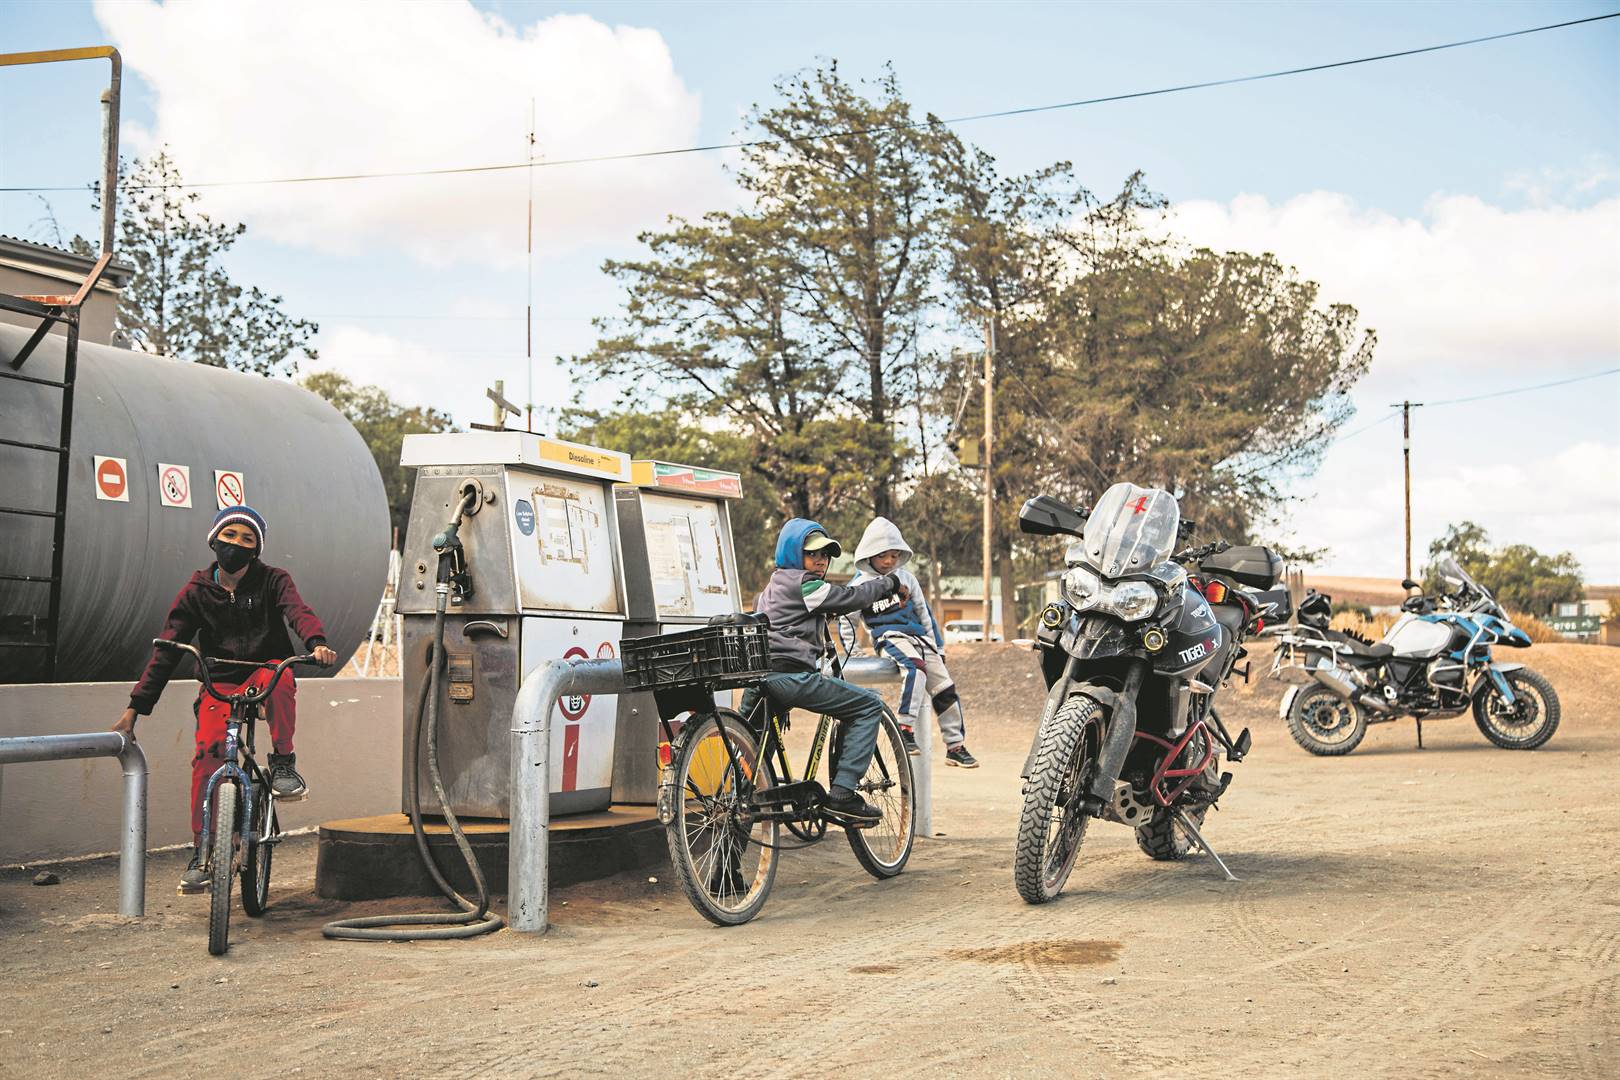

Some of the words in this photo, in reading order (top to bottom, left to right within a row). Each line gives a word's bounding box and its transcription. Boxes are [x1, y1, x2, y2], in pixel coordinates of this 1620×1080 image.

[568, 451, 595, 465] Diesoline
[1125, 496, 1148, 514] 4
[1178, 643, 1207, 664] TIGER
